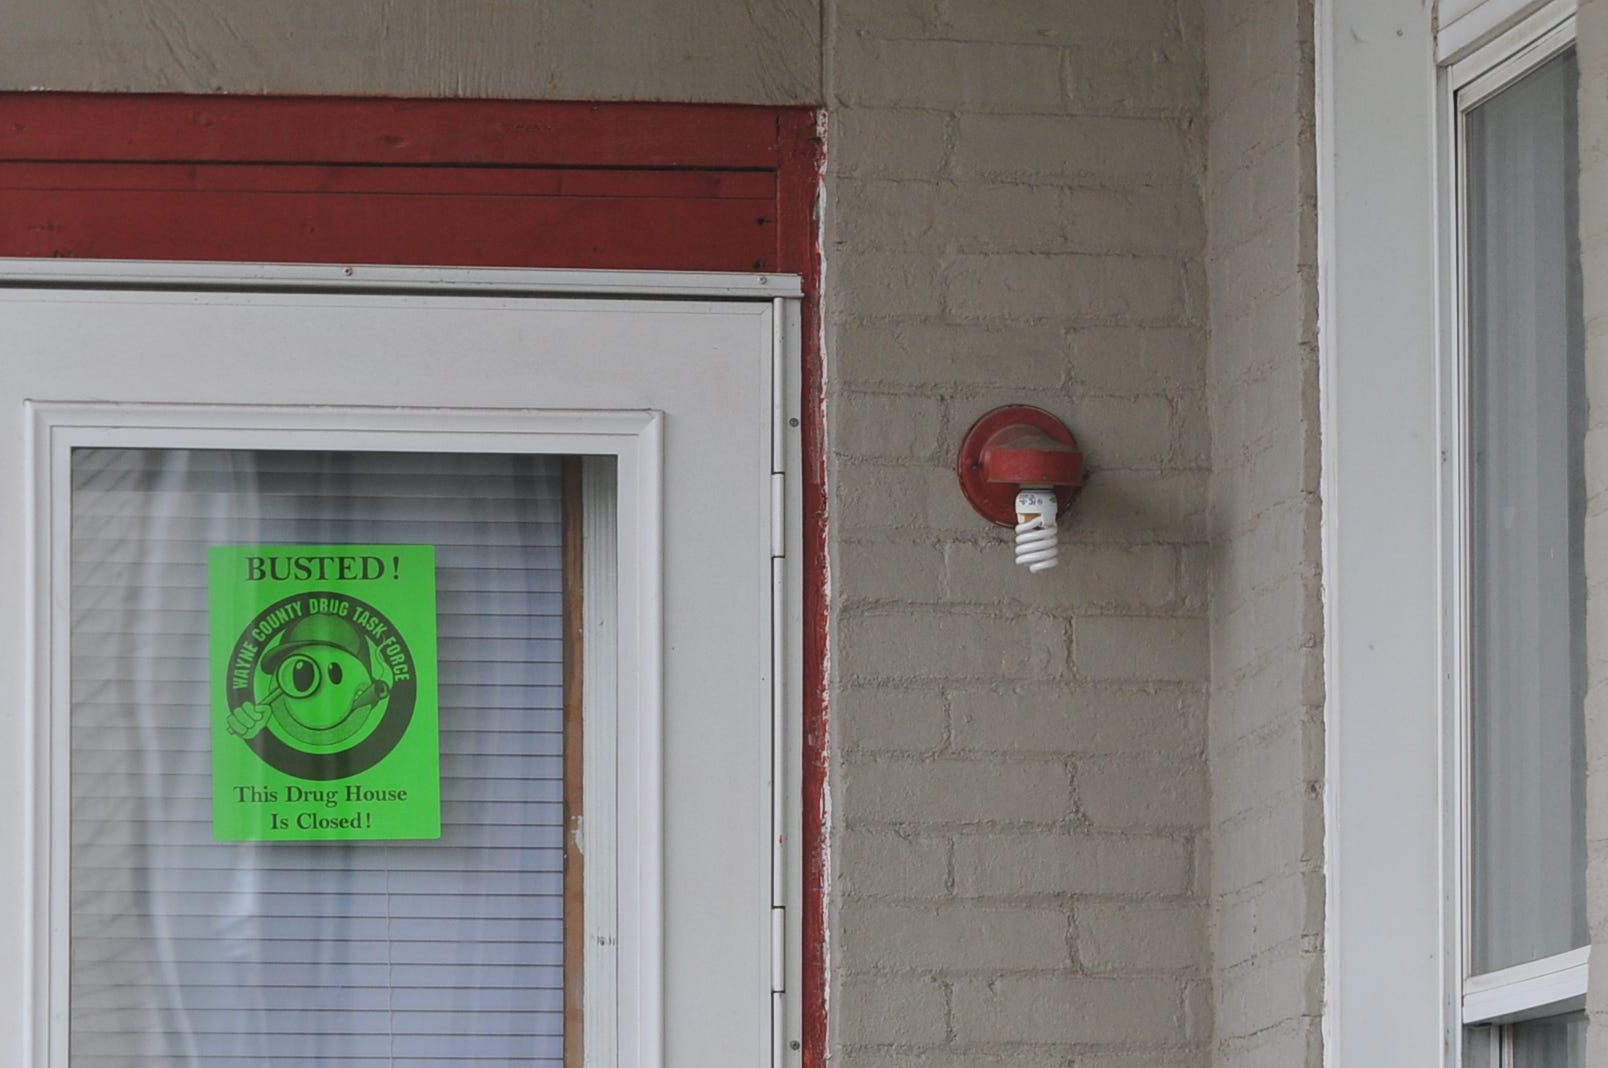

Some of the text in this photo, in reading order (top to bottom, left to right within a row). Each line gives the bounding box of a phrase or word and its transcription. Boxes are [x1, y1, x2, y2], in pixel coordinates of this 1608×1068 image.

[246, 556, 400, 581] BUSTED!
[232, 598, 410, 689] WAYNE COUNTY DRUG TASK FORCE
[233, 785, 408, 808] This Drug House
[271, 812, 372, 830] Is Closed!
